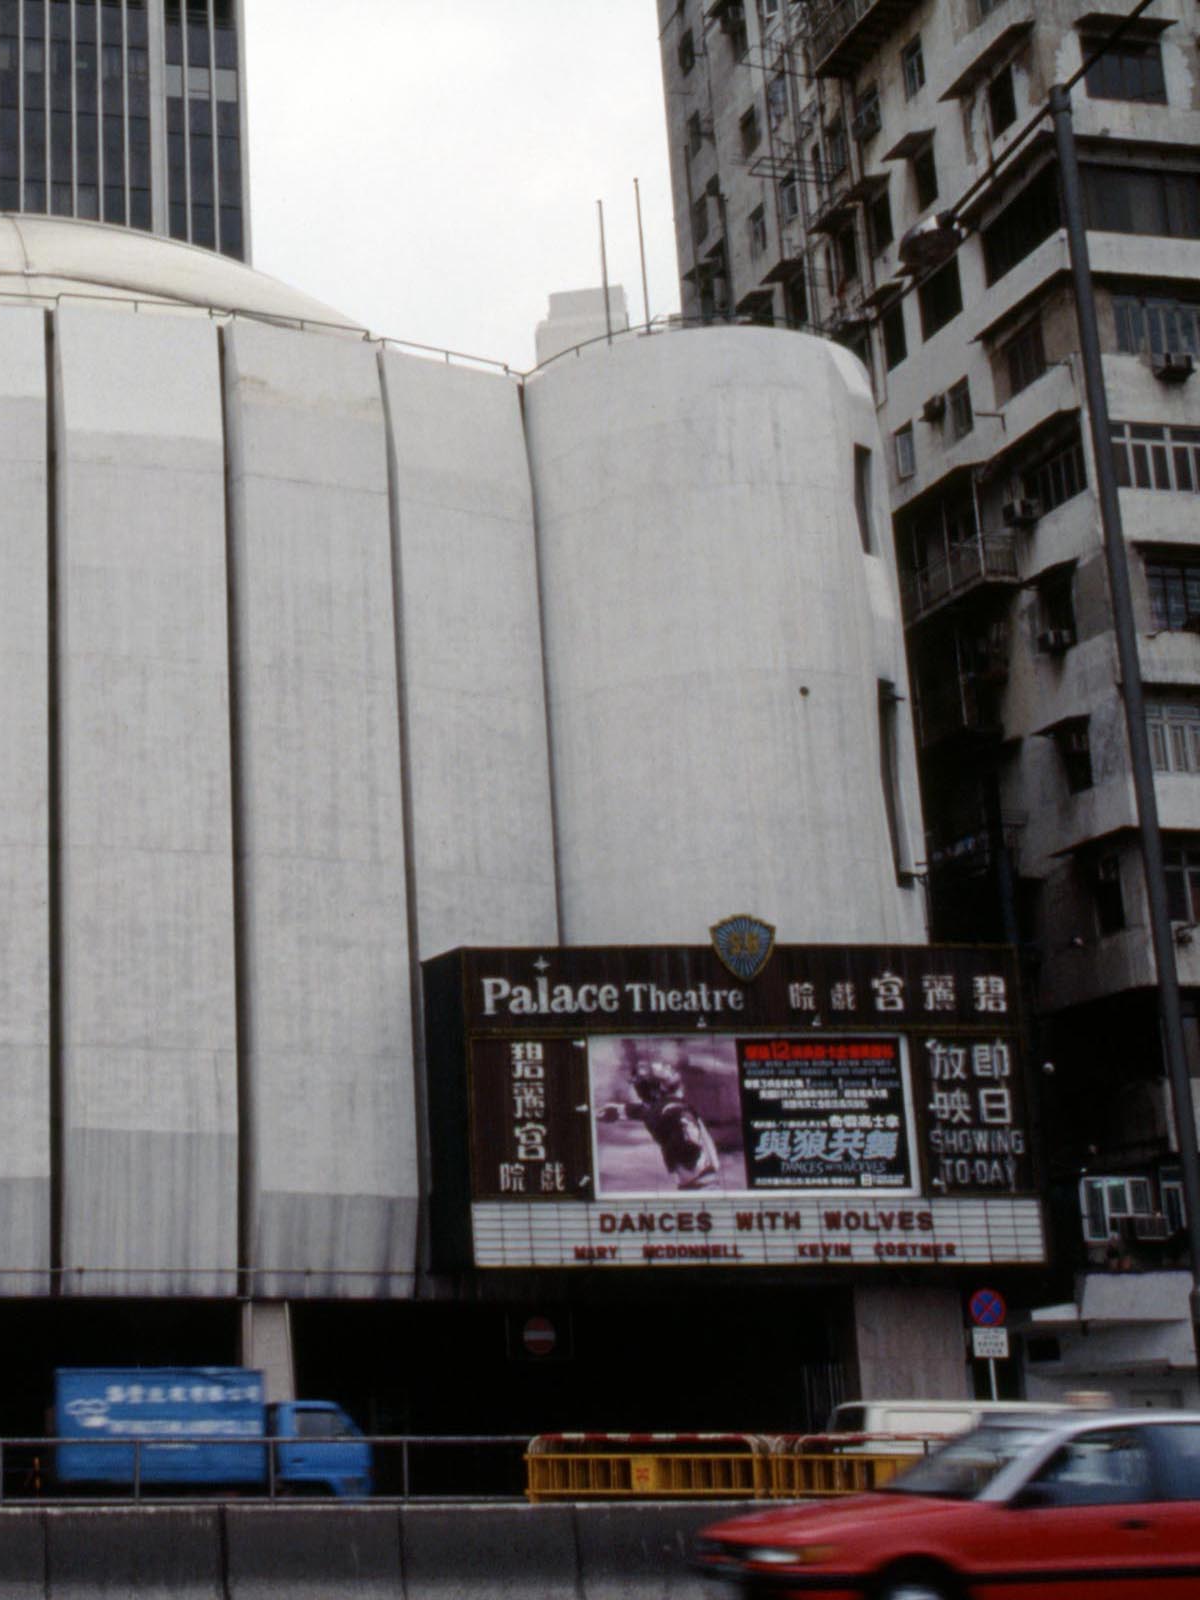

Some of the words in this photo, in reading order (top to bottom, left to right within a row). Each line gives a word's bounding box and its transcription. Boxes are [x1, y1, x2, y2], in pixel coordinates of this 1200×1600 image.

[481, 975, 619, 1015] Palace
[625, 982, 745, 1012] Theatre
[929, 1129, 1025, 1155] SHOWING
[599, 1211, 712, 1233] DANCES
[736, 1211, 800, 1231] WITH
[823, 1210, 934, 1232] WOLVES
[573, 1244, 619, 1260] MARY
[642, 1243, 744, 1259] MCDONNELL
[798, 1242, 853, 1257] KEVIN
[873, 1242, 957, 1257] COSTNER
